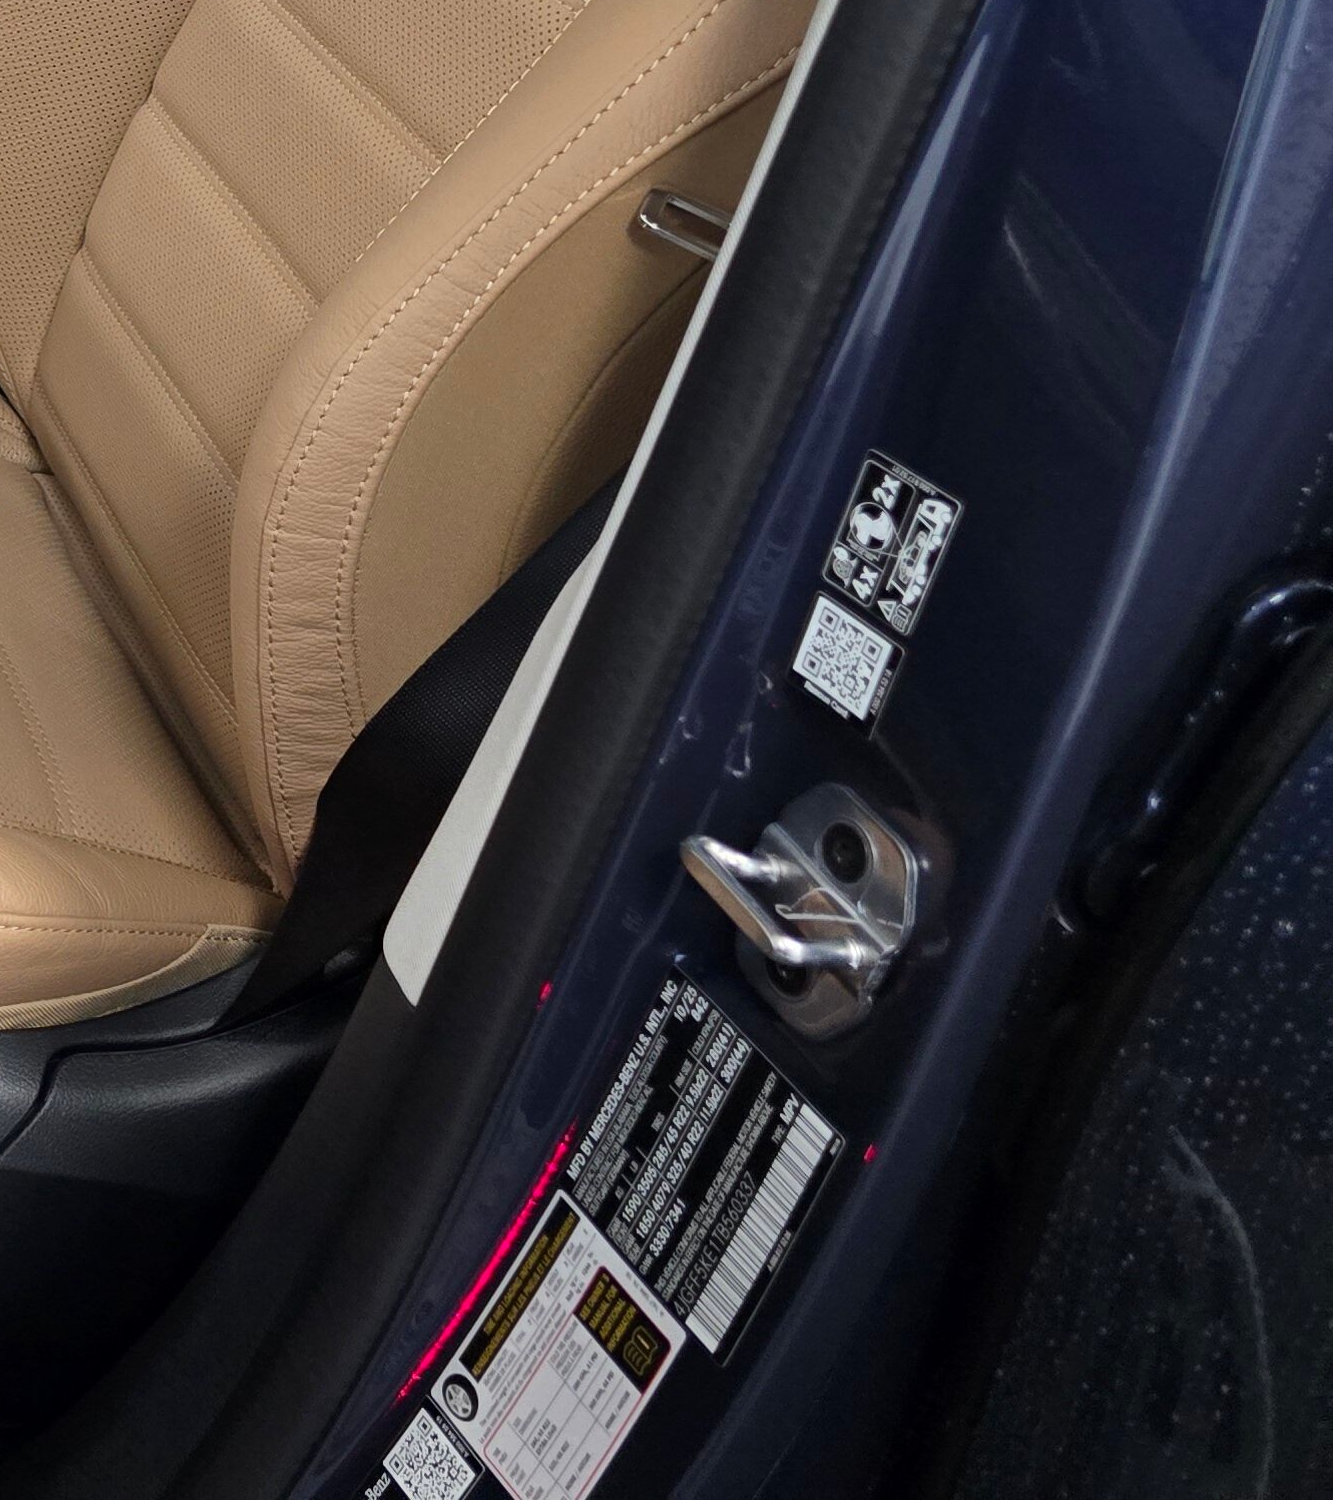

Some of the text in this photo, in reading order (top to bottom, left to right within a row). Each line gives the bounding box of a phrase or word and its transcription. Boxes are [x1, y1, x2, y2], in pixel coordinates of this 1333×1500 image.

[870, 470, 901, 510] 2x
[848, 561, 879, 602] 4x
[672, 982, 700, 1025] 10/25
[689, 993, 709, 1023] 842
[703, 1019, 736, 1071] 280(41)
[718, 1035, 751, 1087] 300(44)
[566, 1149, 587, 1182] MFD
[579, 1135, 595, 1157] BY
[587, 1050, 641, 1143] MERCEDES-BENZ
[632, 1028, 652, 1058] U.S.
[659, 976, 679, 1006] INC
[778, 1091, 801, 1125] MPV
[650, 1102, 691, 1171] 285/45 R22
[665, 1117, 705, 1188] 325/40 R22
[635, 1162, 658, 1198] 3505
[649, 1178, 672, 1214] 4079
[620, 1190, 643, 1225] 1590
[634, 1206, 657, 1241] 1850
[664, 1195, 686, 1230] 7341
[647, 1222, 671, 1259] 3330
[670, 1167, 759, 1322] 4JGFF5KE1TB560337
